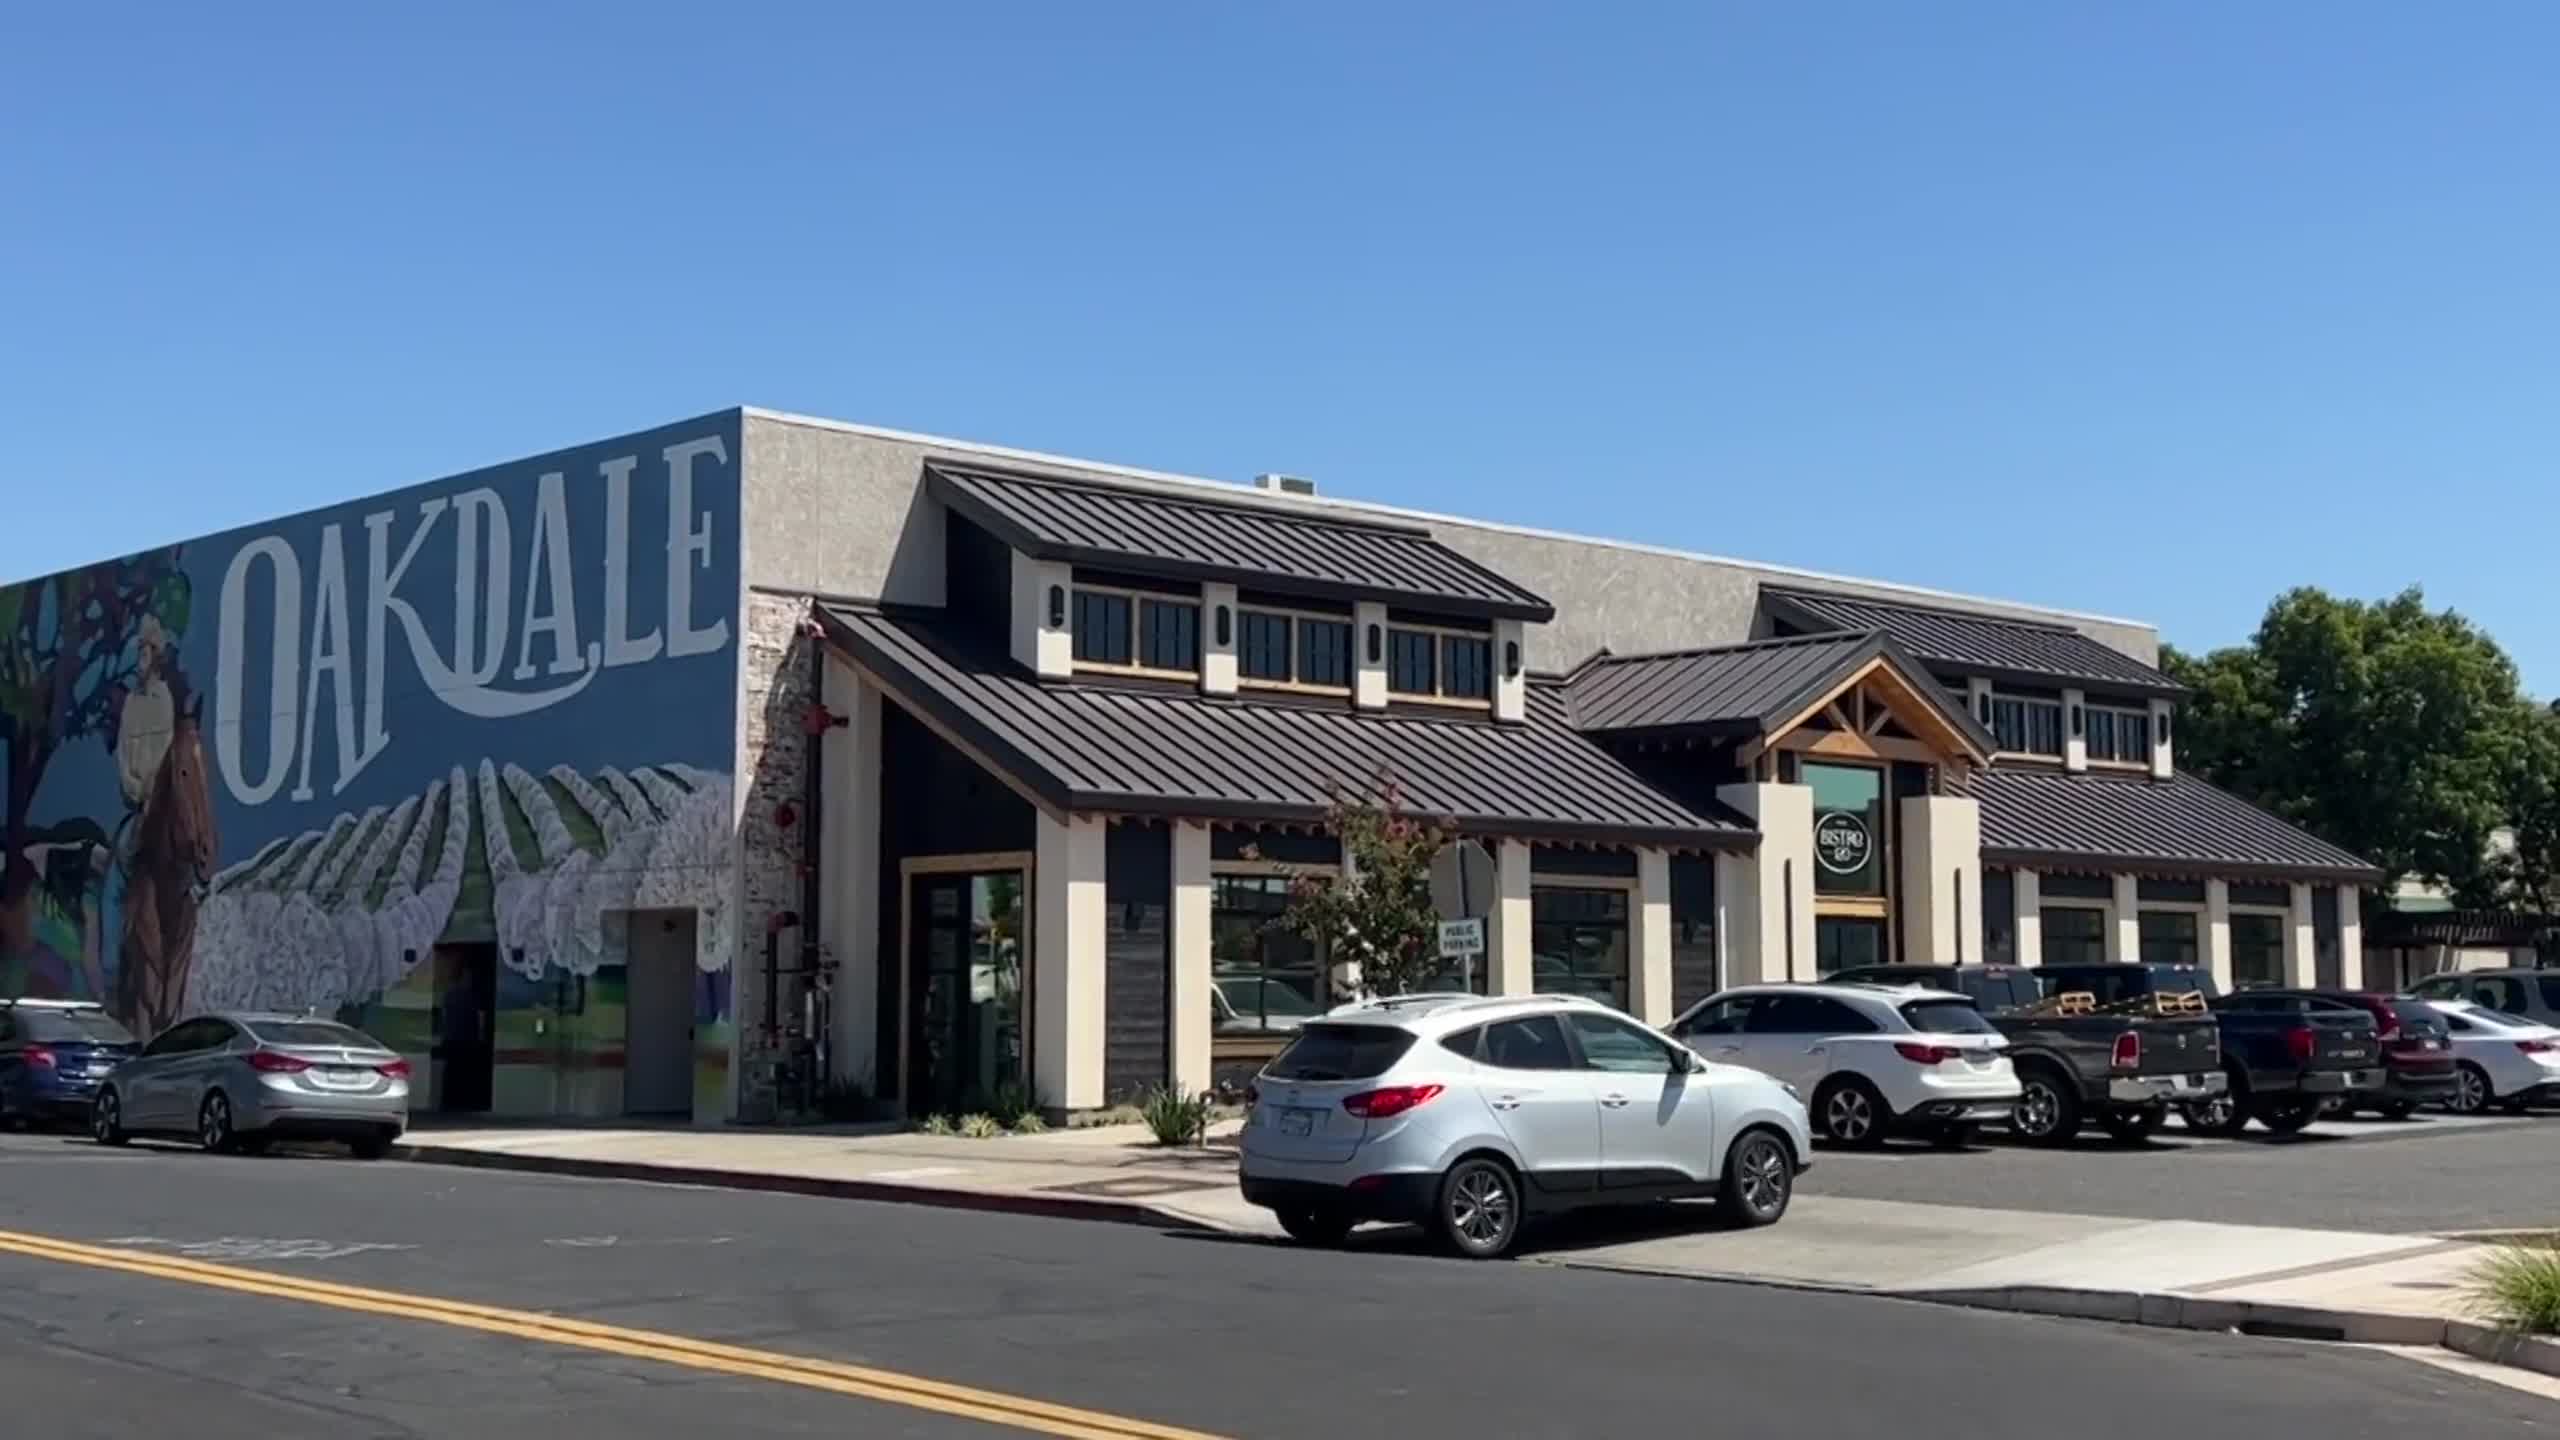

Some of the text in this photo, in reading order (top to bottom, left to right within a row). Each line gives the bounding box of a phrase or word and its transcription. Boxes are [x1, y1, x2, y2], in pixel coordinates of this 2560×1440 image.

[215, 435, 730, 804] OAKDALE
[1820, 828, 1864, 848] BISTRO
[1445, 923, 1474, 937] PUBLIC
[1443, 936, 1480, 951] PARKING
